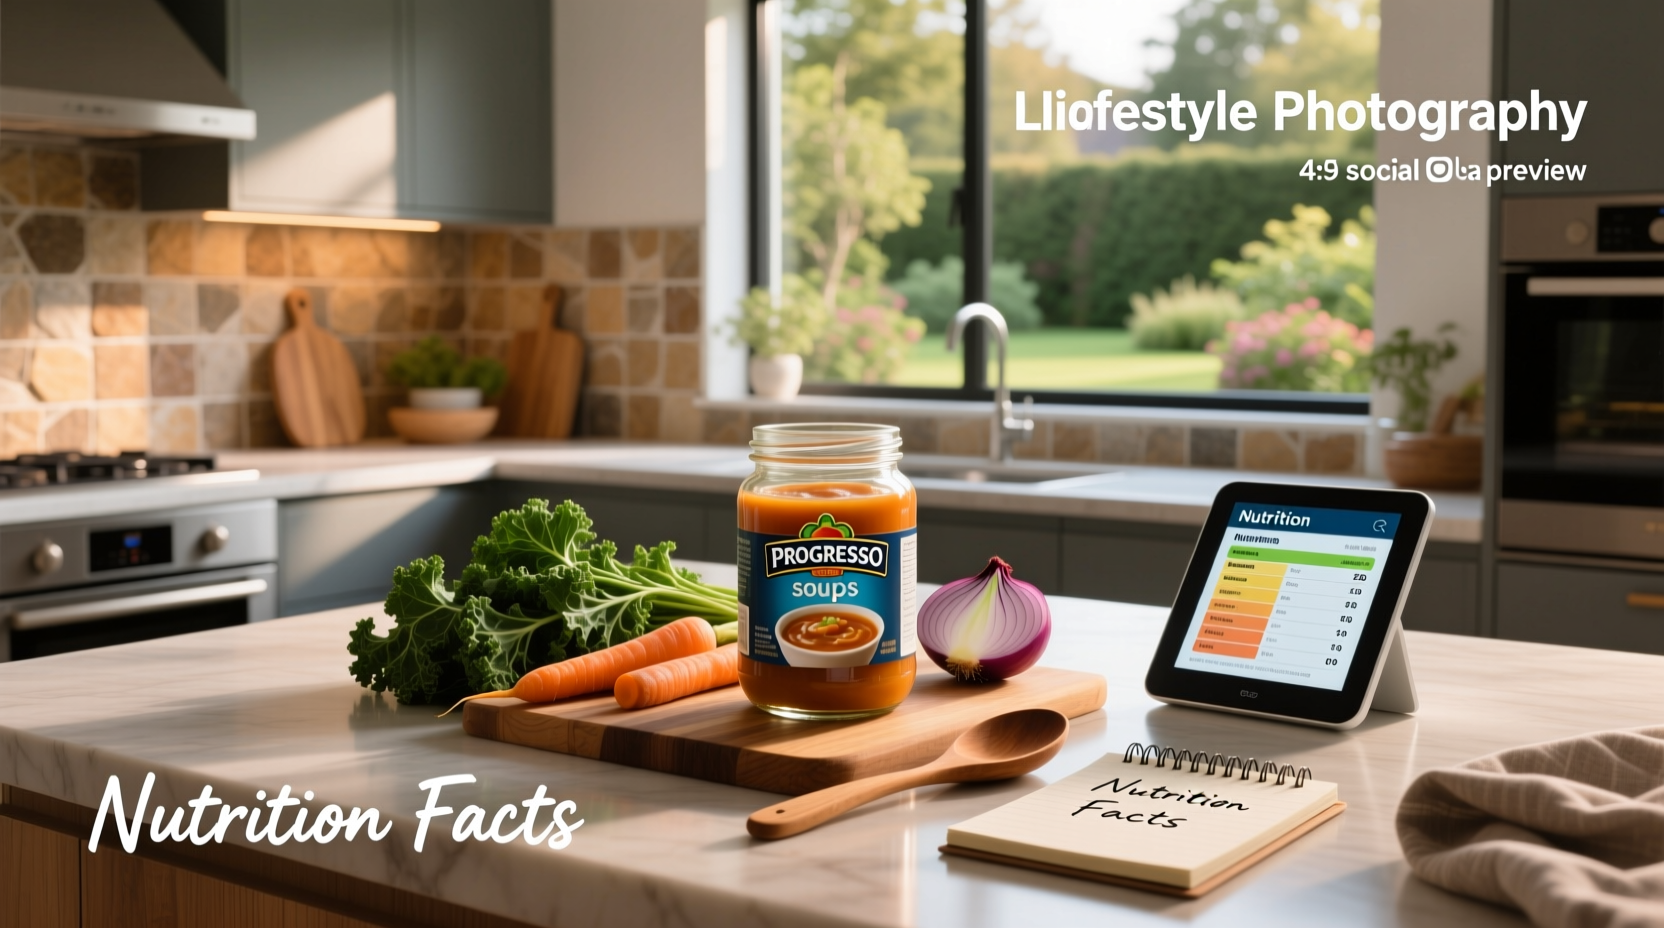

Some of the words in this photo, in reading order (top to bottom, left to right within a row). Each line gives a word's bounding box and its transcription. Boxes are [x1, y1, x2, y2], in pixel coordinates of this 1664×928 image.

[1238, 509, 1311, 528] Nutrition
[771, 545, 884, 568] PROGRESSO
[792, 581, 859, 603] soups
[1090, 778, 1250, 811] Nutrition
[1071, 799, 1188, 829] Facts
